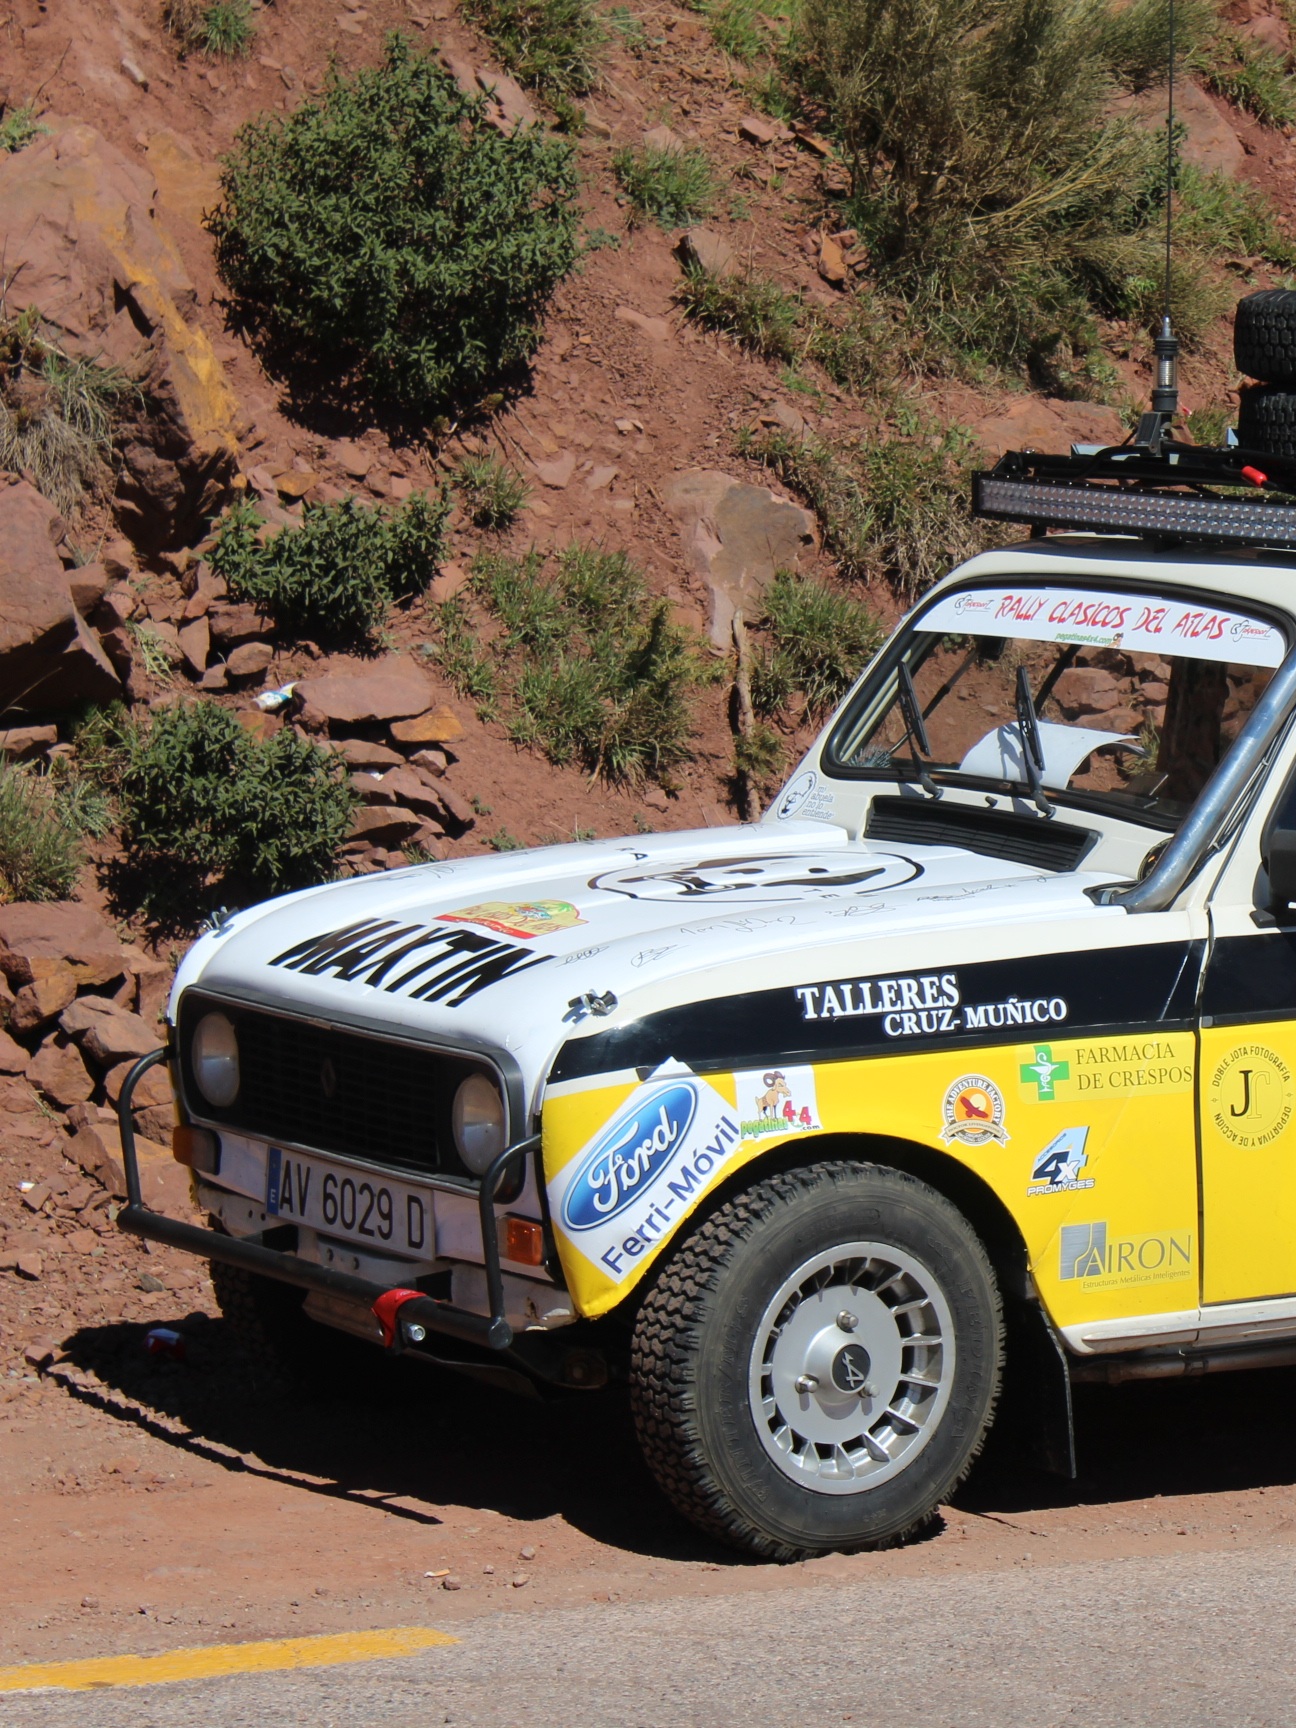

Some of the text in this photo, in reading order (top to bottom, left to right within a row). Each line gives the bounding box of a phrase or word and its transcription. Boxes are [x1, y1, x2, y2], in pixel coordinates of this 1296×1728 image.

[995, 595, 1231, 639] RALLY CLASICOS DEL ATLAS
[796, 974, 960, 1020] TALLERES
[964, 998, 1068, 1029] MUÑICO
[1075, 1043, 1175, 1065] FARMACIA
[1212, 1045, 1291, 1087] DOBLE JOTA FOTOGRAFÍA
[948, 1078, 989, 1105] ADVENTURE
[1077, 1066, 1193, 1091] DE CRESPOS
[1238, 1135, 1249, 1147] DE
[1257, 1106, 1292, 1145] DEPORTIVA
[587, 1105, 678, 1213] Ford
[279, 1159, 425, 1249] AV 6029 D
[600, 1115, 740, 1275] Ferri-Móvil
[1027, 1178, 1096, 1197] PROMYGES
[1083, 1235, 1191, 1277] AIRON
[1082, 1269, 1190, 1289] Estructuras Metálicas Inteligentes
